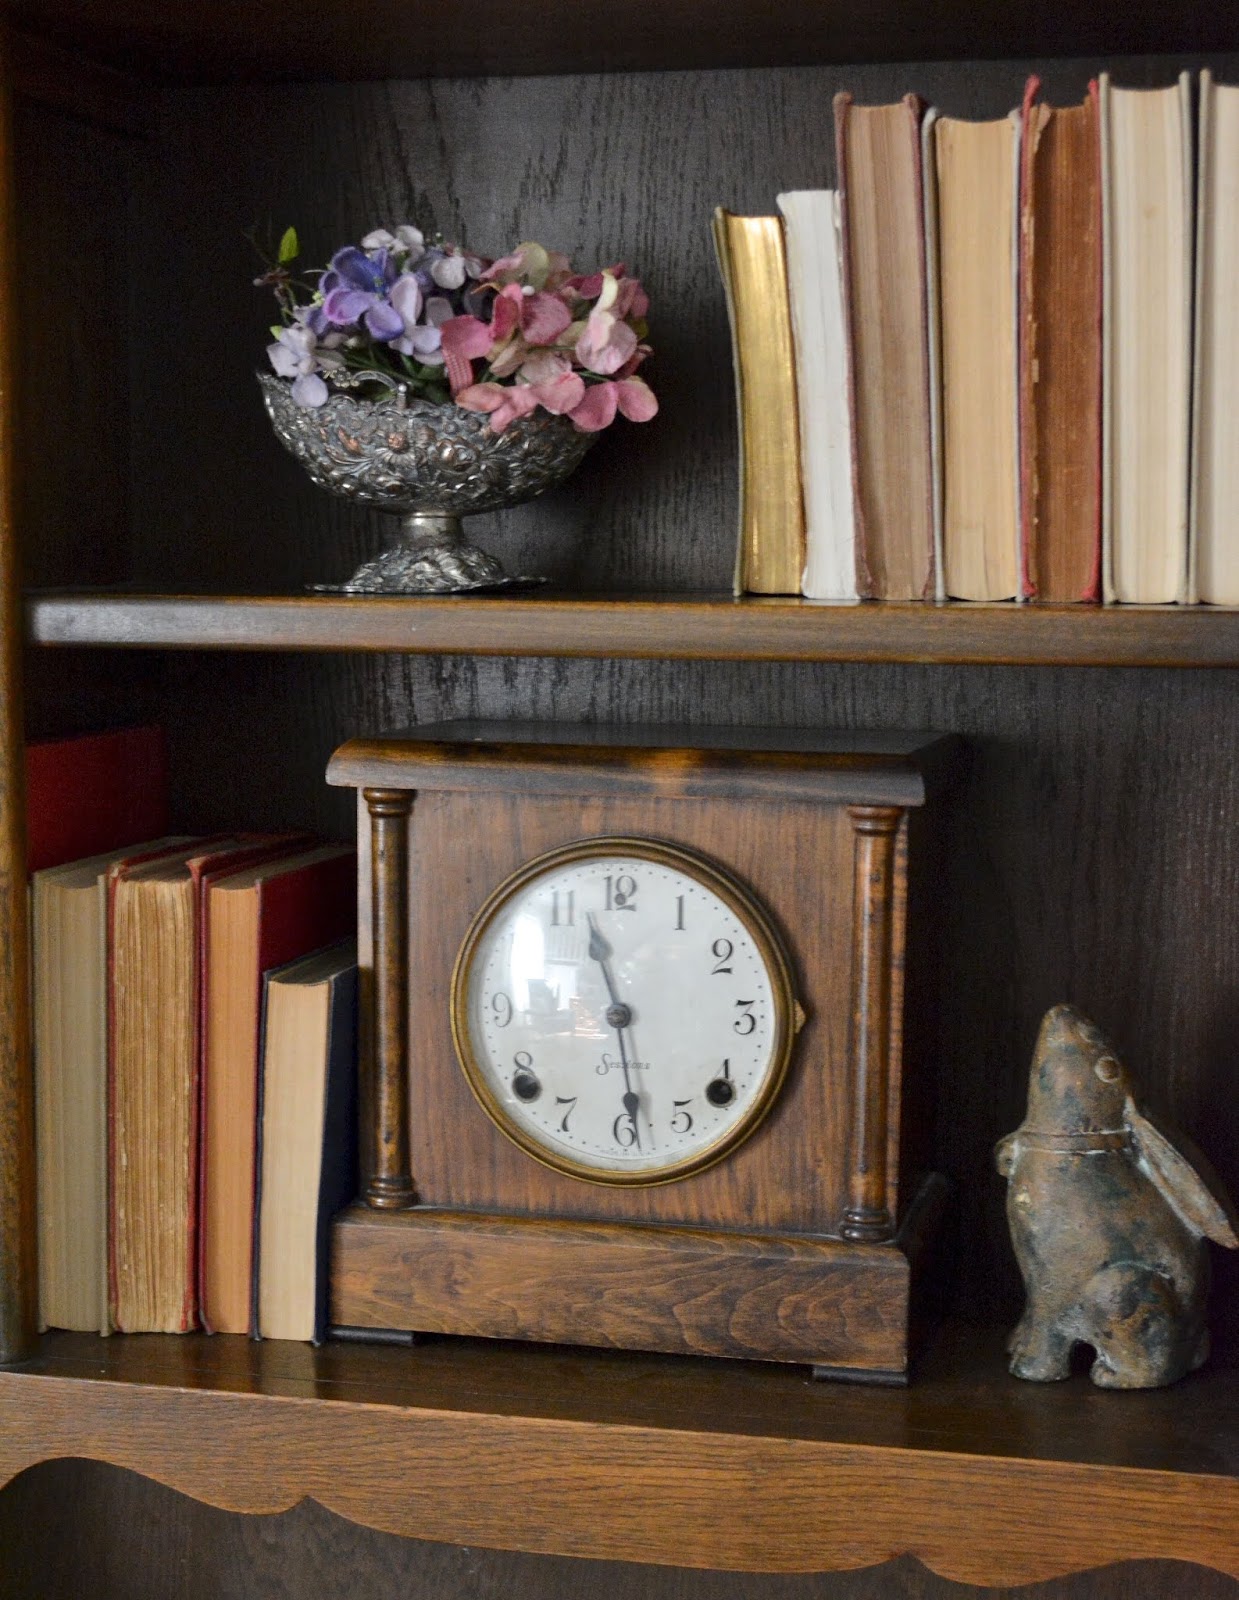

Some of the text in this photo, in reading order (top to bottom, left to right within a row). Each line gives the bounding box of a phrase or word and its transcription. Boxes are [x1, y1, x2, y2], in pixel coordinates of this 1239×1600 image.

[550, 890, 575, 926] 11
[603, 875, 637, 912] 12
[674, 895, 687, 931] 1
[711, 938, 733, 975] 2
[491, 992, 513, 1028] 9
[734, 999, 756, 1035] 3
[555, 1096, 577, 1132] 7
[612, 1113, 638, 1147] 6
[671, 1098, 694, 1134] 5
